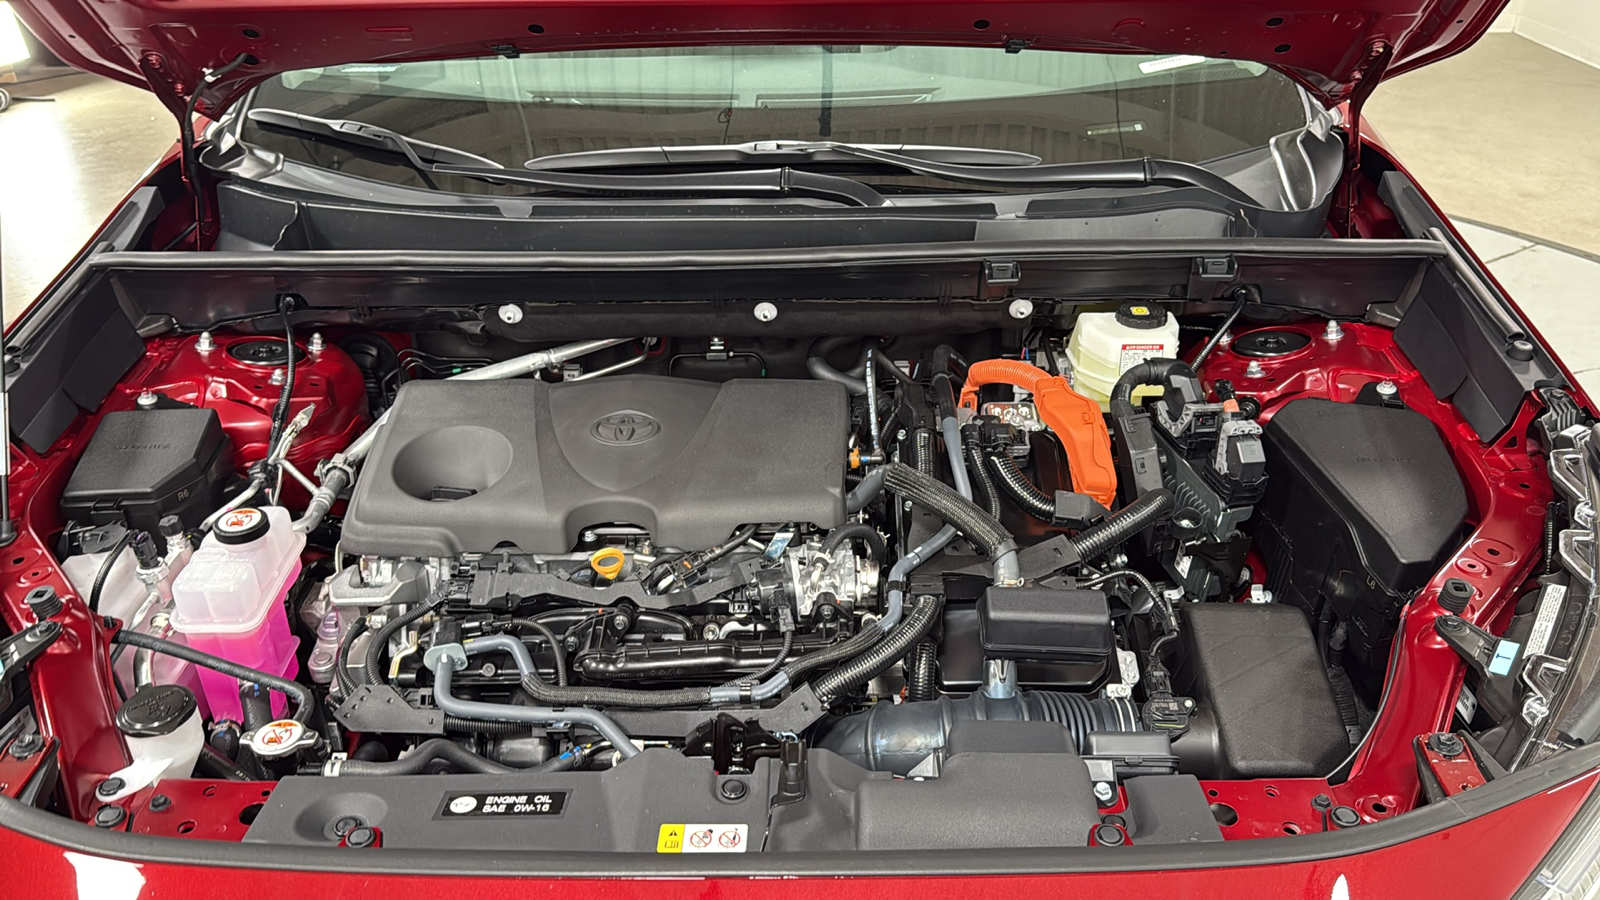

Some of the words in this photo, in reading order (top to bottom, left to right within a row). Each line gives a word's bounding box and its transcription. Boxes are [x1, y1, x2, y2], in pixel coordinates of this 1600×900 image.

[177, 489, 189, 501] R6
[485, 795, 528, 804] ENGINE
[534, 795, 552, 803] OIL
[482, 804, 506, 812] SAE
[513, 804, 550, 812] 0W-16
